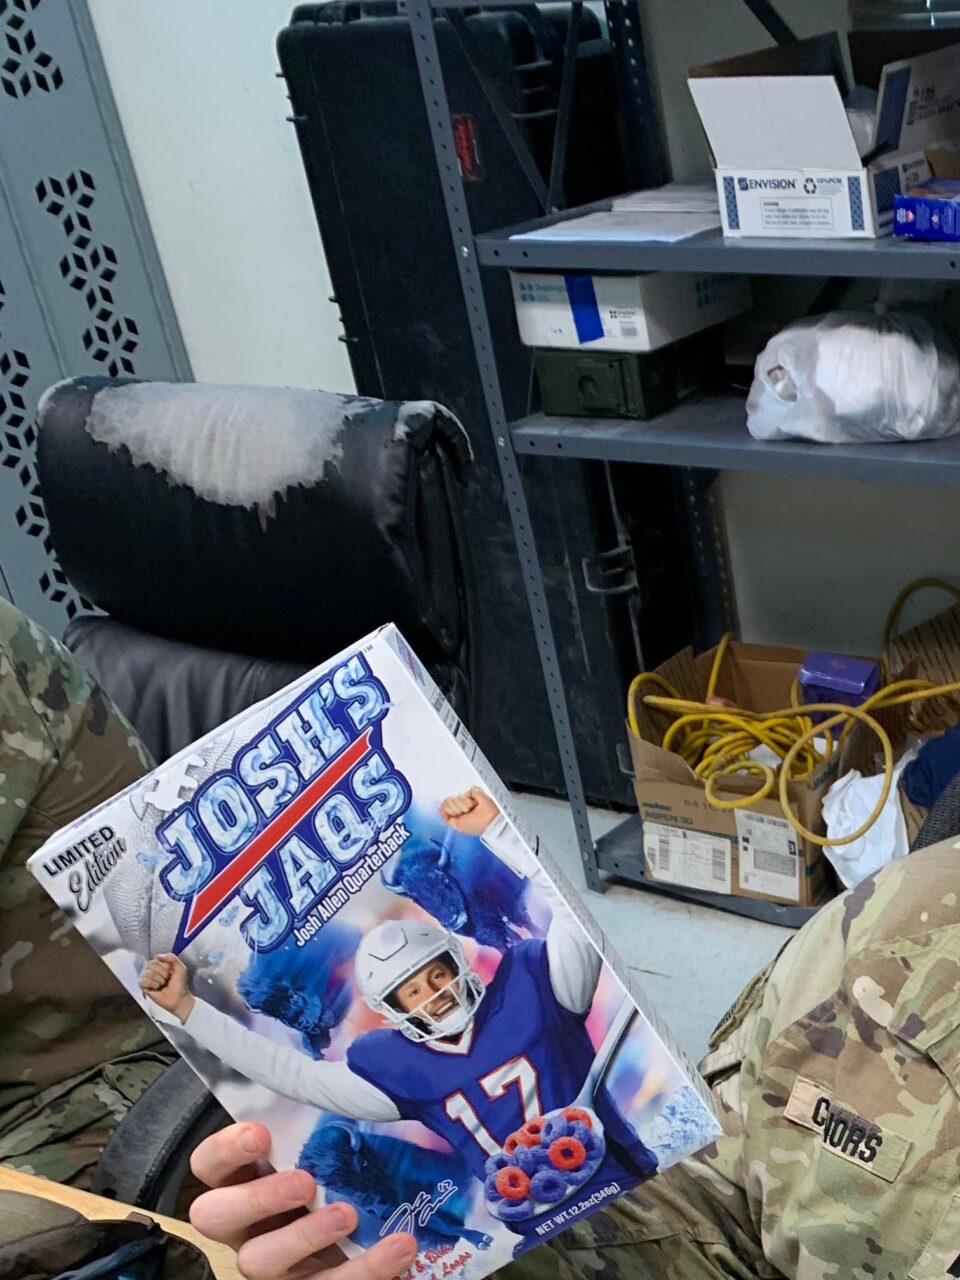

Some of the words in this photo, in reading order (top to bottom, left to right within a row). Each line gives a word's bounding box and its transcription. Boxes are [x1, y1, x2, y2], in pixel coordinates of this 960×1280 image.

[750, 178, 796, 190] ENVISION
[157, 655, 389, 899] JOSH'S
[44, 825, 115, 877] LIMITED
[69, 836, 127, 911] Edition
[240, 750, 409, 948] JAQS
[293, 914, 322, 946] Josh
[317, 894, 349, 922] Allen
[342, 824, 411, 894] Quarterback
[445, 1053, 543, 1156] 17
[535, 1219, 555, 1236] NET
